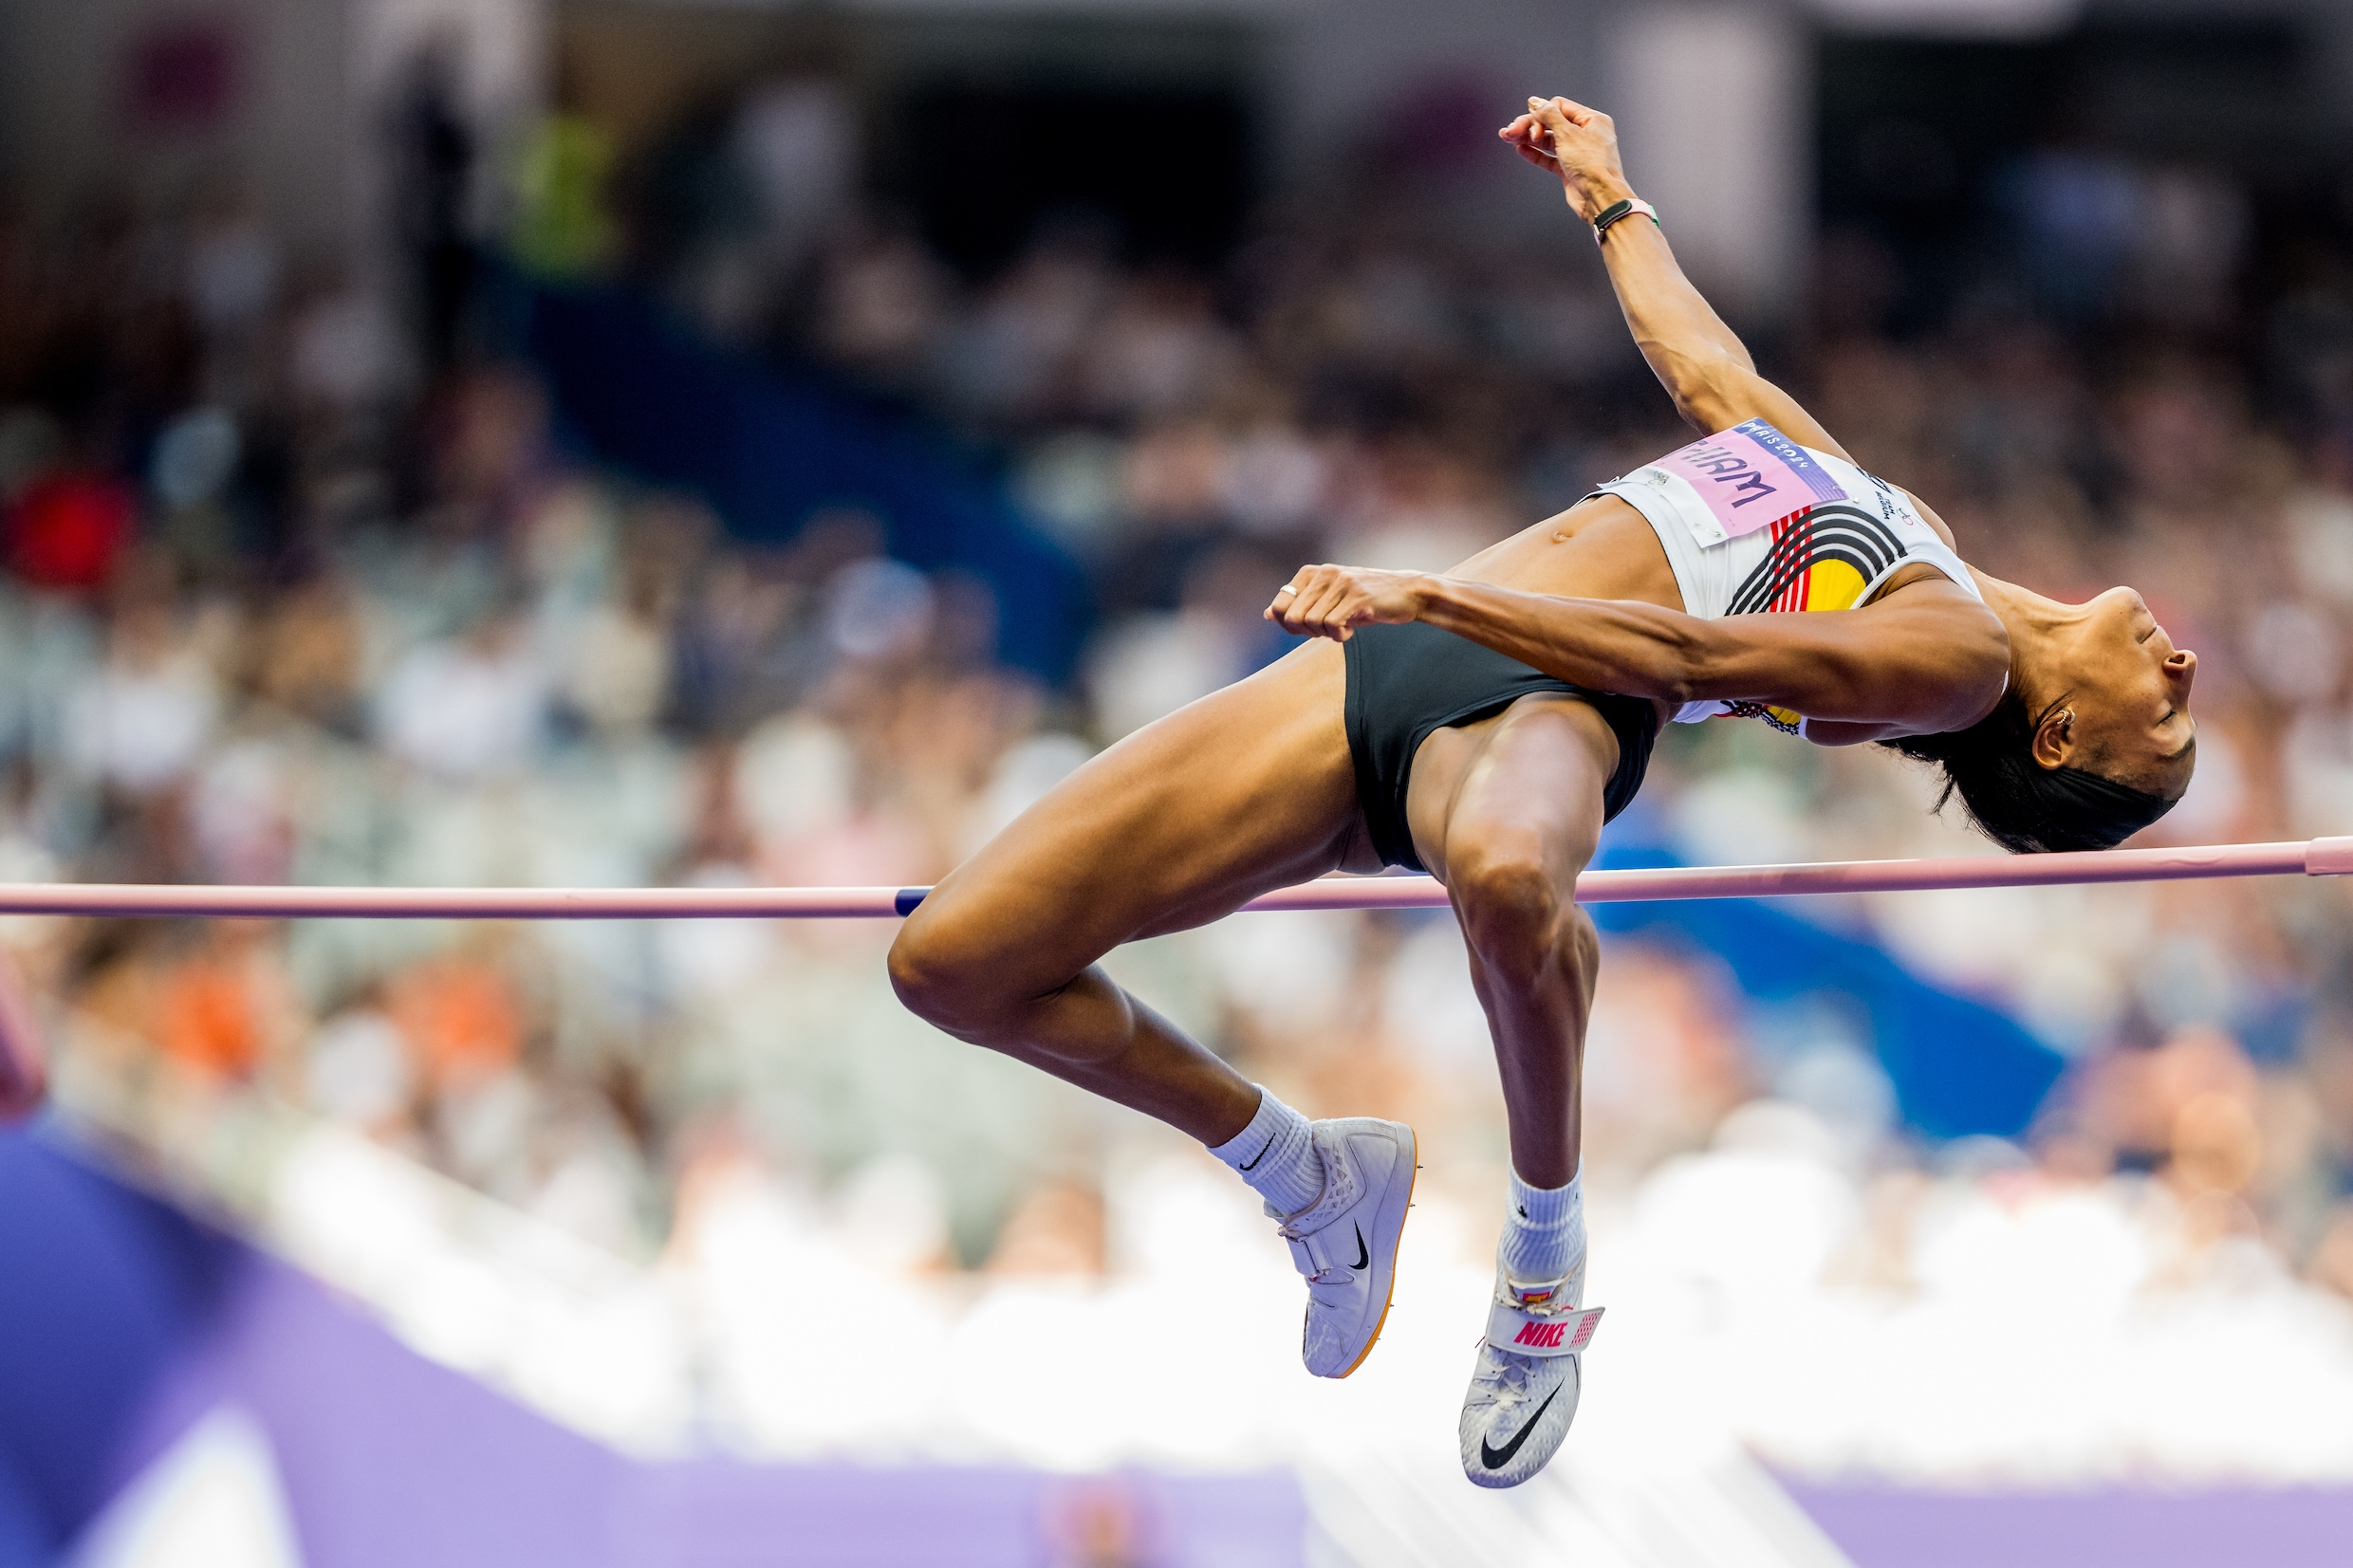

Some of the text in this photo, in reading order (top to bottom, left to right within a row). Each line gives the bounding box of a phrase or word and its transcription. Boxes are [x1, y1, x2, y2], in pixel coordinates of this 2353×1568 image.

[1742, 422, 1808, 468] PARIS 2024
[1513, 1320, 1568, 1348] NIKE
